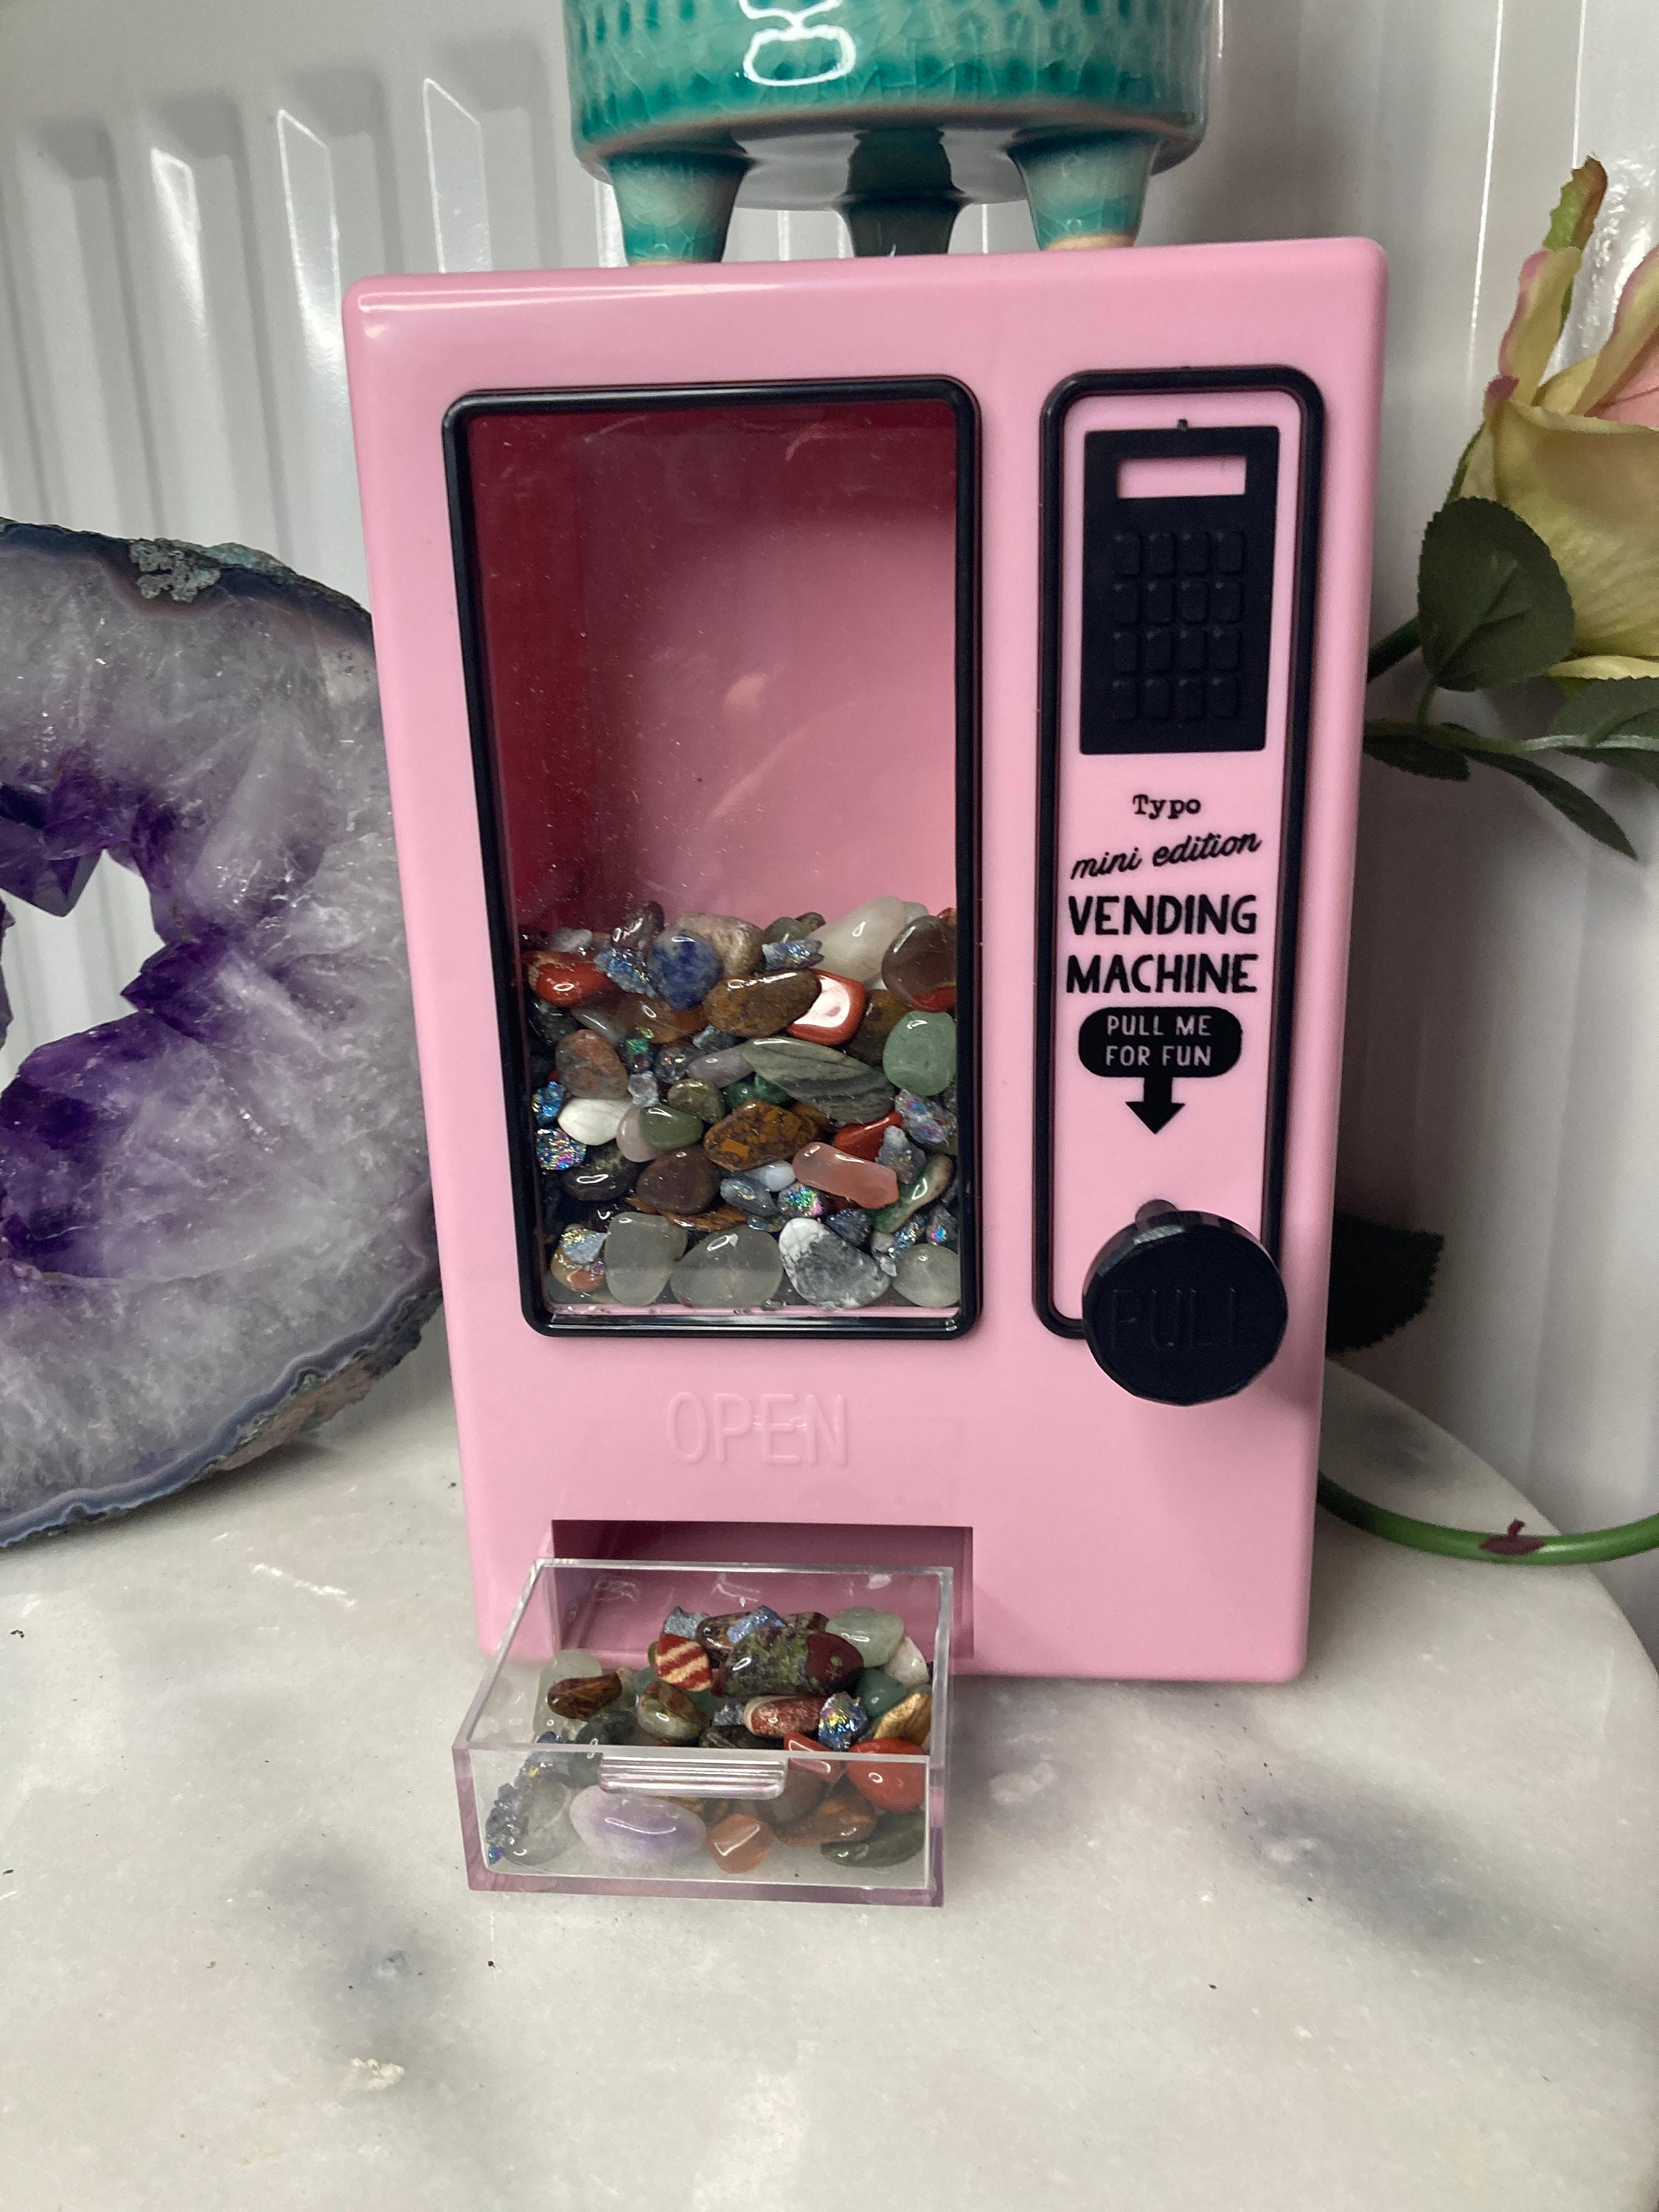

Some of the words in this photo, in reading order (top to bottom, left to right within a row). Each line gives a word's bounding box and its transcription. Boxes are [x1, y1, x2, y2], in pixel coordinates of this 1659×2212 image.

[1132, 794, 1201, 819] Typo
[1071, 847, 1141, 880] mini
[1152, 832, 1262, 867] edition
[1068, 894, 1256, 935] VENDING
[1065, 953, 1258, 994] MACHINE
[1107, 1015, 1164, 1036] PULL
[1175, 1015, 1212, 1036] ME
[1105, 1046, 1150, 1066] FOR
[1161, 1046, 1212, 1066] FUN
[666, 1391, 848, 1466] OPEN
